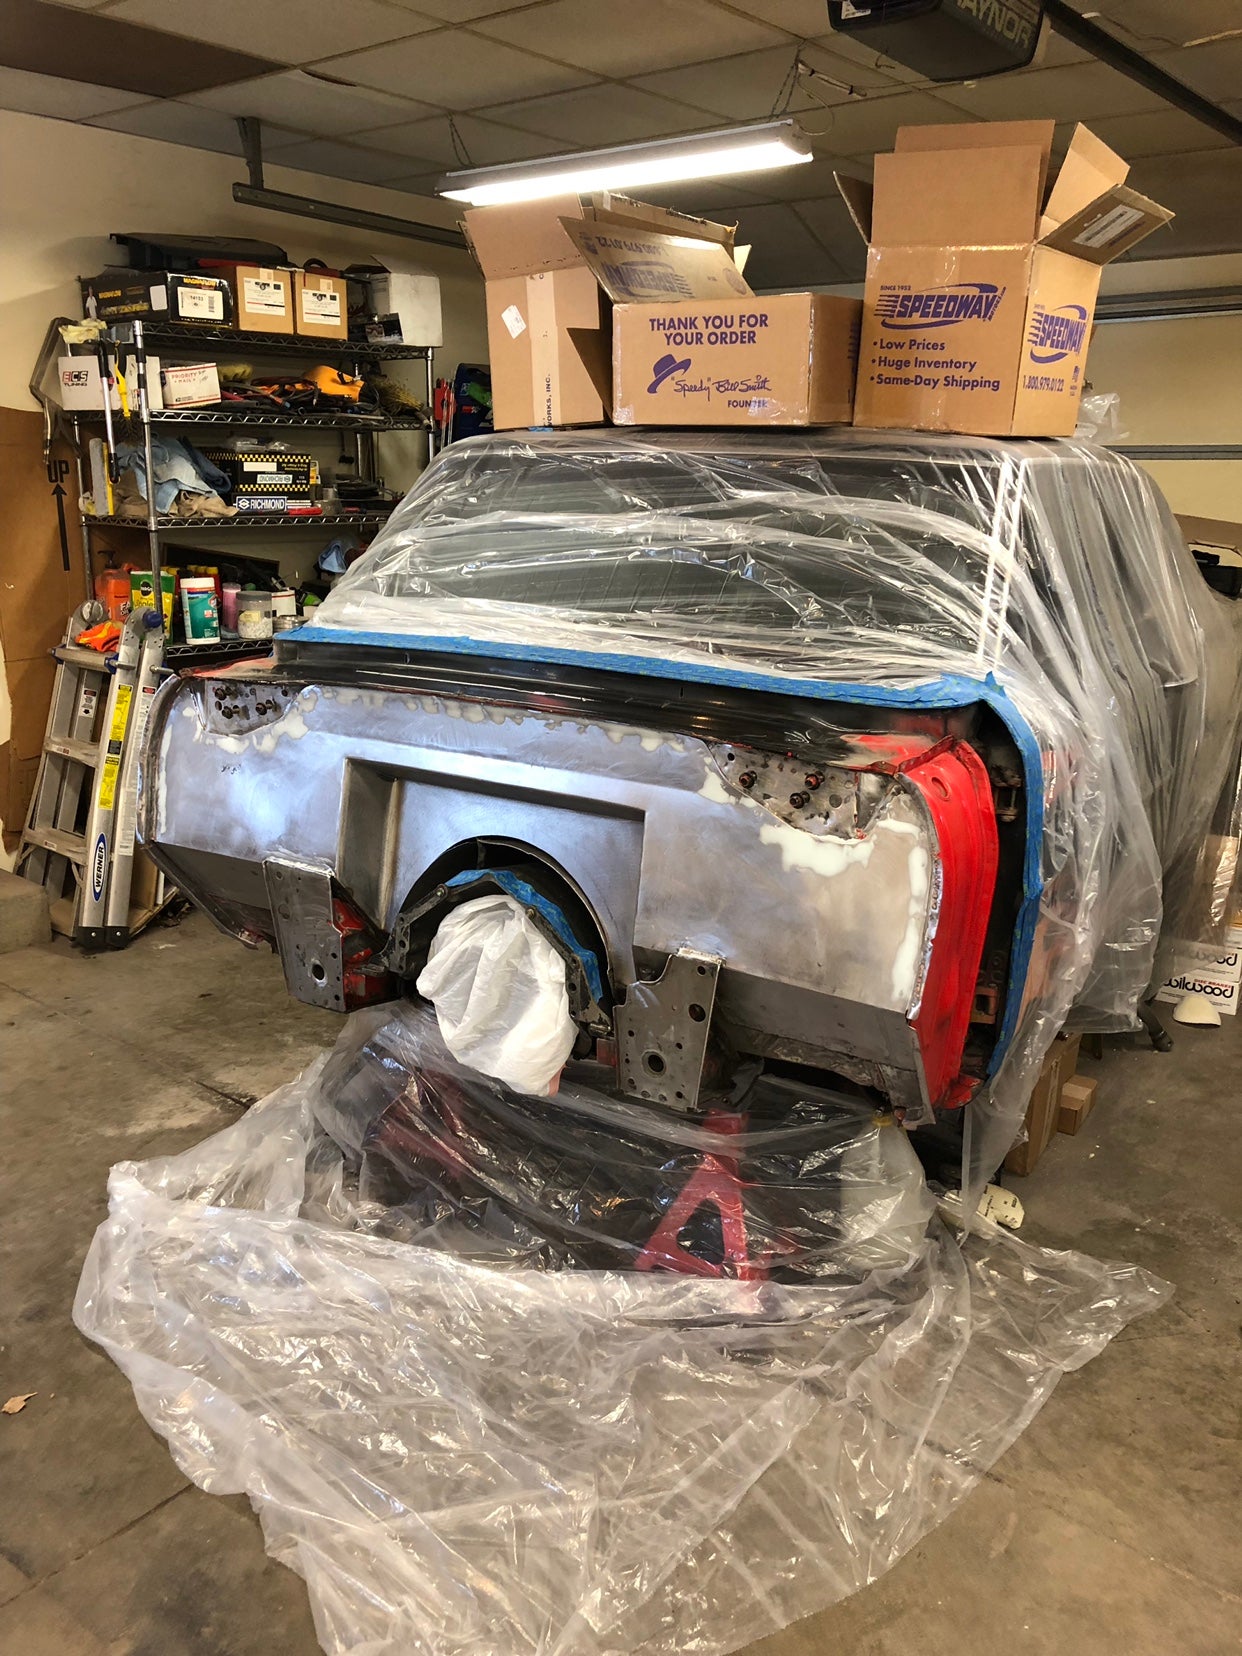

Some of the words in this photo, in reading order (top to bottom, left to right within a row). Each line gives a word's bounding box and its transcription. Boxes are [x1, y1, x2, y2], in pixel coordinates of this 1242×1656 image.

[896, 294, 998, 319] SPEEDWAY
[649, 316, 698, 331] THANK
[702, 315, 734, 330] YOU
[738, 313, 769, 328] FOR
[664, 332, 704, 346] YOUR
[707, 330, 757, 345] ORDER
[1039, 314, 1086, 353] SPEEDWAY
[880, 338, 905, 350] Low
[908, 339, 945, 351] Prices
[878, 356, 911, 371] Huge
[914, 357, 977, 372] Inventory
[62, 370, 88, 382] ECS
[876, 373, 940, 389] Same-Day
[943, 375, 1000, 392] Shipping
[47, 459, 70, 483] UP
[250, 499, 285, 510] RICHMOND
[95, 846, 104, 888] WERNER
[1163, 976, 1234, 999] wilwood
